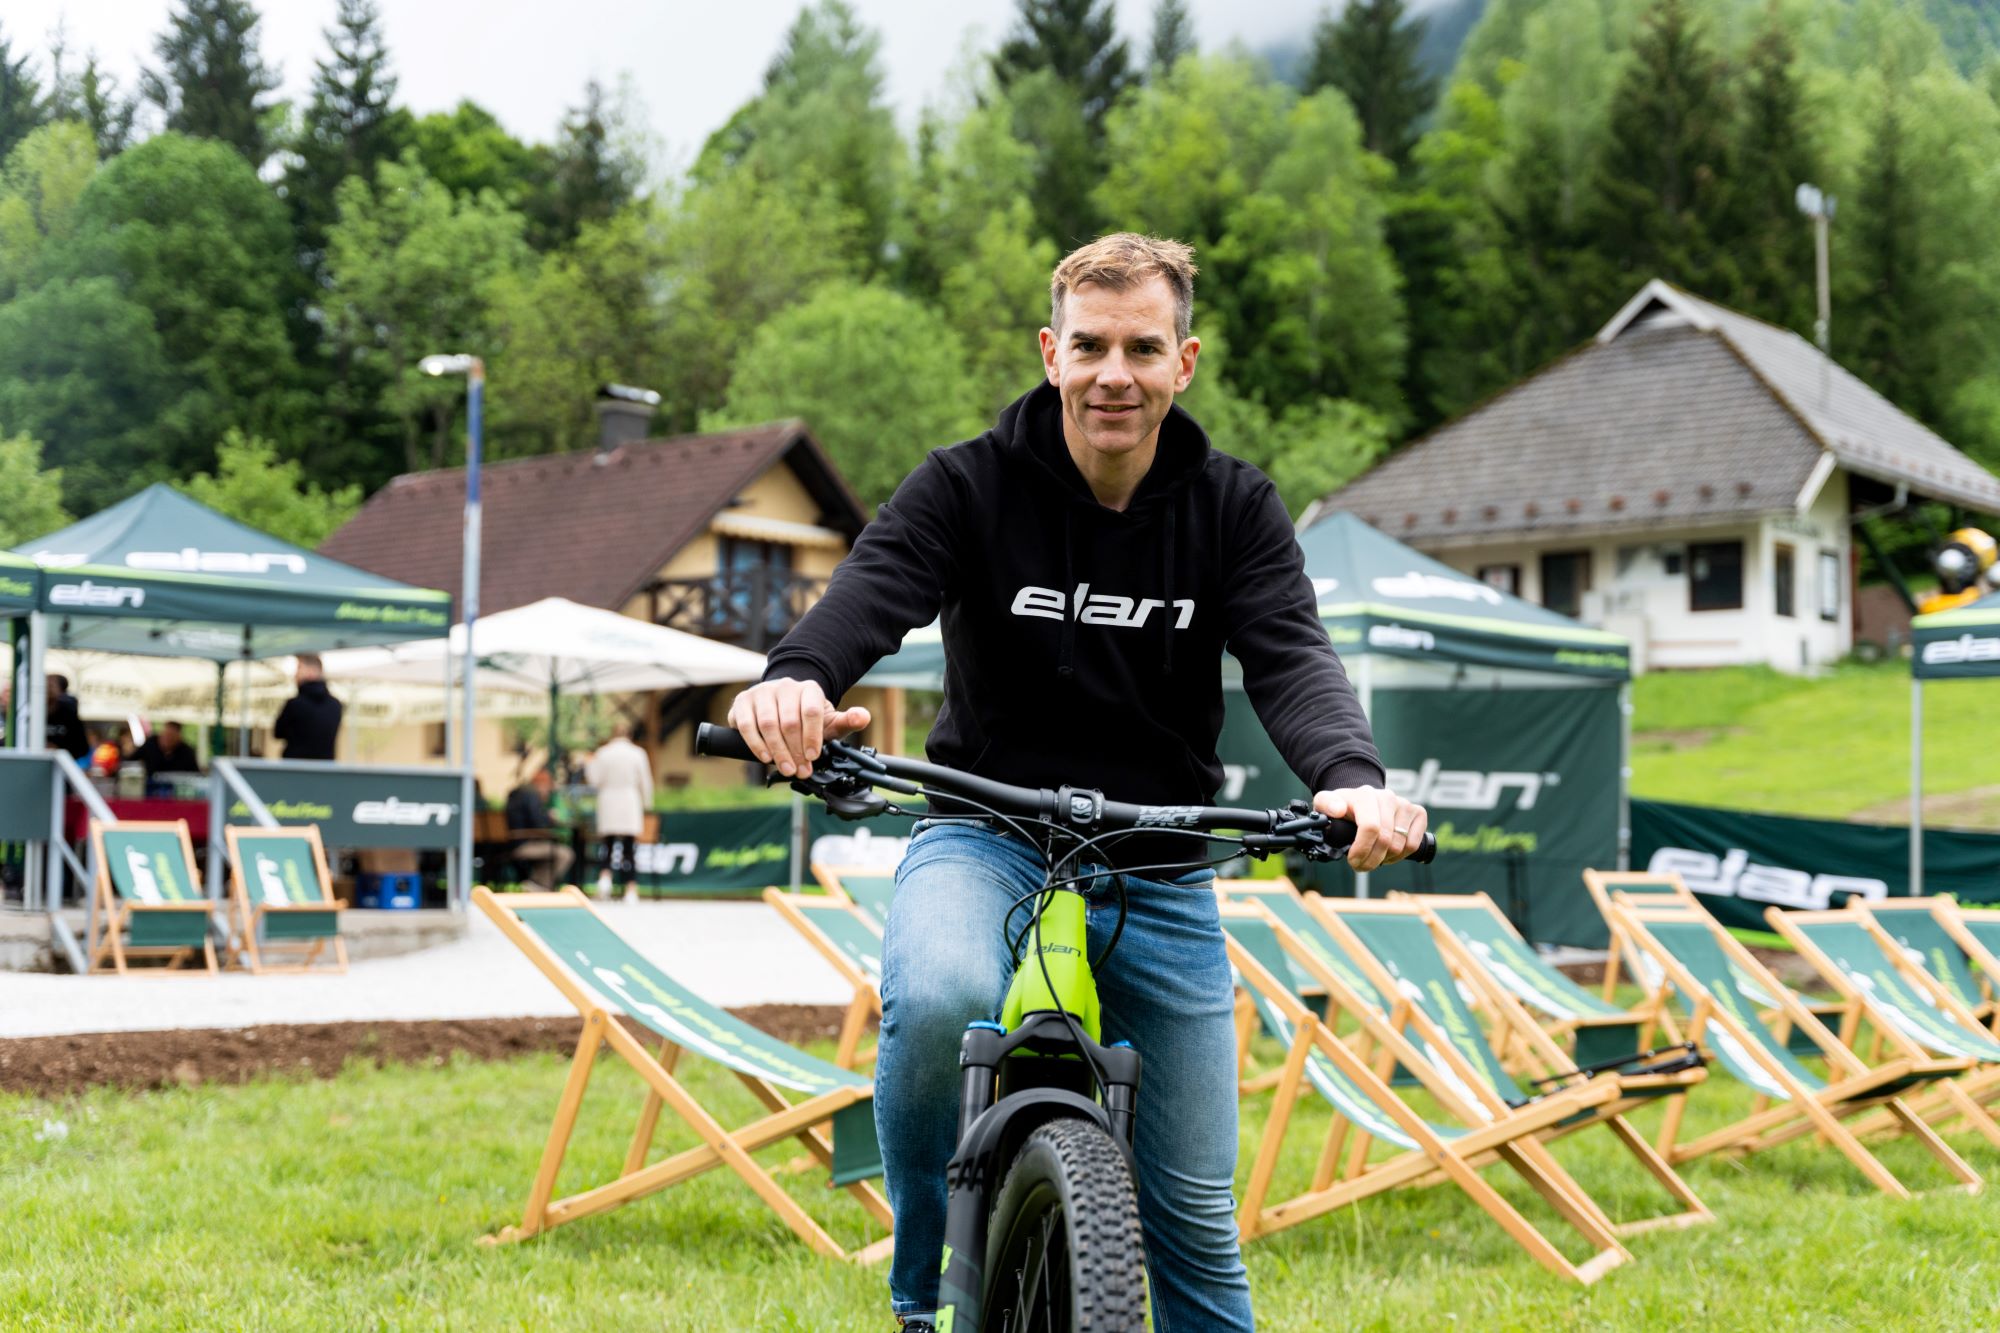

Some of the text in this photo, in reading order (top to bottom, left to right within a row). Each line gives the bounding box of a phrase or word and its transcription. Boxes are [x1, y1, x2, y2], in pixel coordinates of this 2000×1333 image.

[49, 580, 145, 608] elan
[1010, 583, 1195, 629] elan
[1922, 633, 2000, 664] ela
[1385, 758, 1541, 810] elan
[352, 796, 451, 826] elan
[1648, 847, 1888, 910] elan
[1034, 943, 1080, 957] elan
